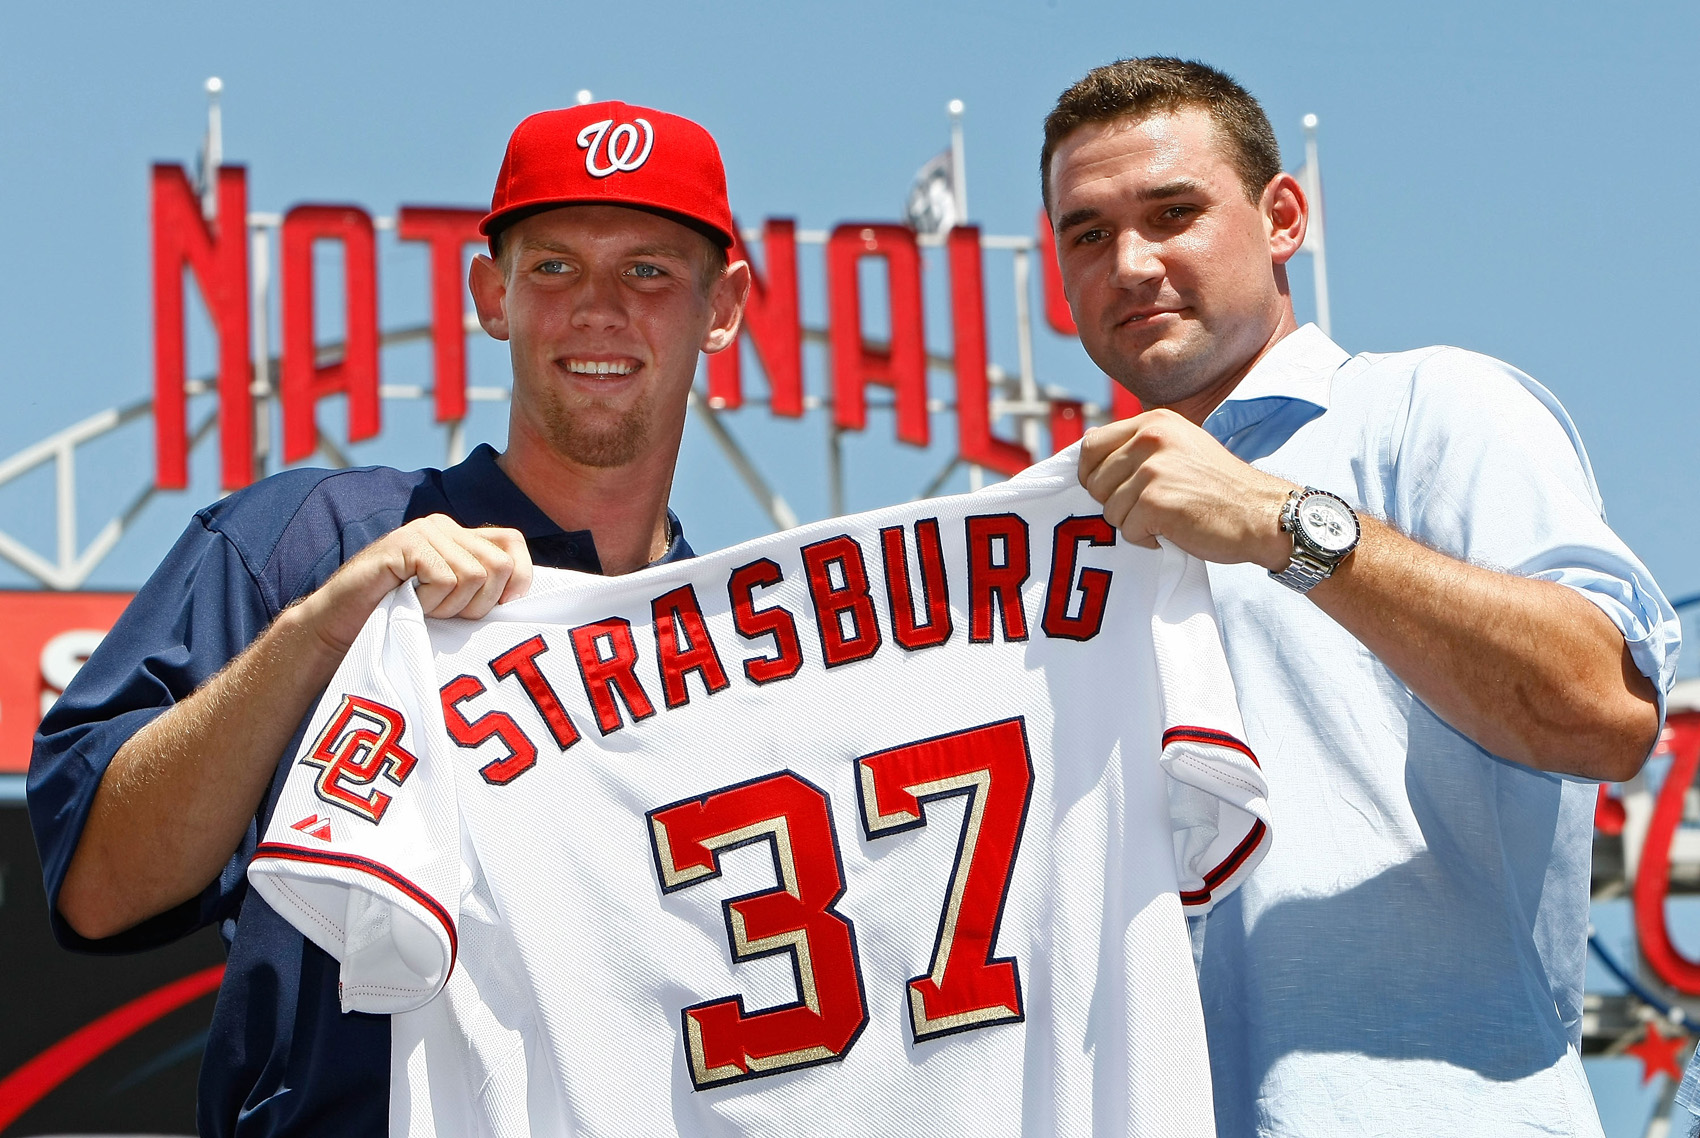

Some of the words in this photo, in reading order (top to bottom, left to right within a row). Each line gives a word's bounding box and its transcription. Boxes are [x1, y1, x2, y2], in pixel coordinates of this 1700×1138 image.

[576, 118, 655, 178] W
[151, 162, 1141, 492] NATNAL
[439, 512, 1117, 786] STRASBURG
[645, 715, 1035, 1092] 37
